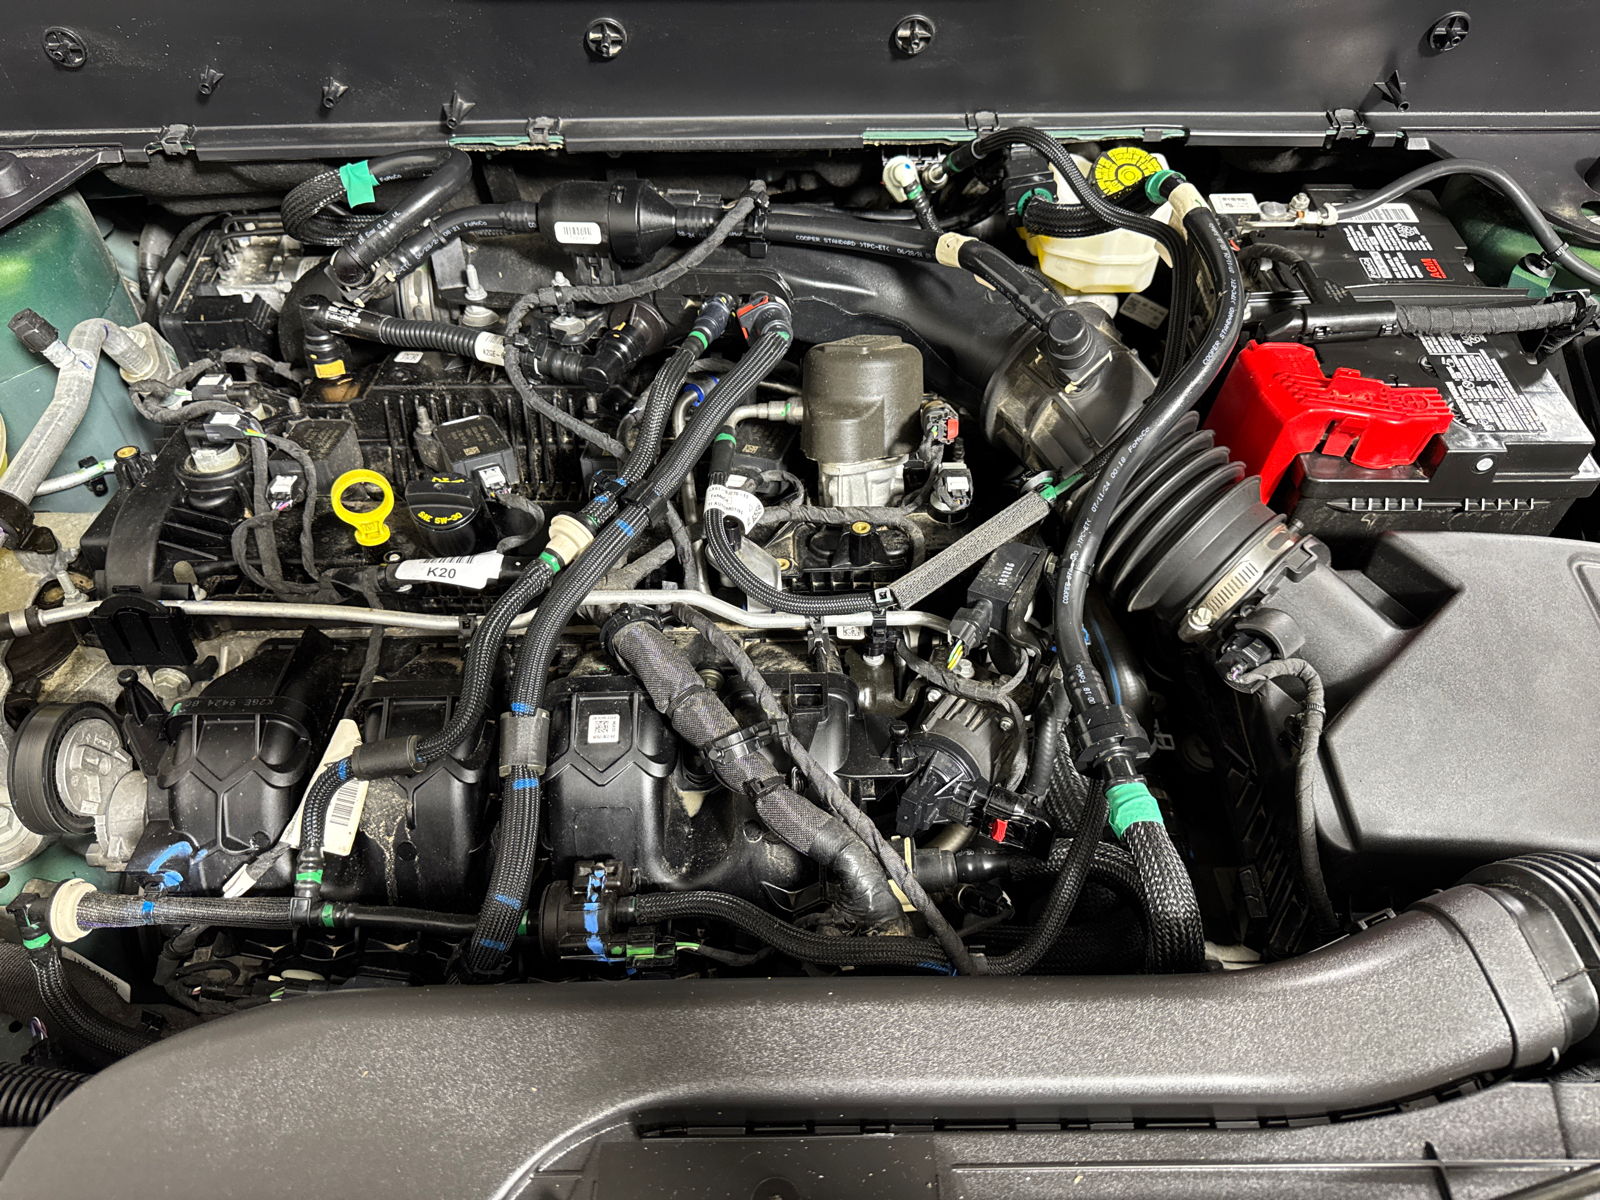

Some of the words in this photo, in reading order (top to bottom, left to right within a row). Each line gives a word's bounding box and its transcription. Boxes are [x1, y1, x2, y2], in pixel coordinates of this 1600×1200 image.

[795, 234, 821, 244] COOPER
[823, 236, 856, 247] STANDARD
[1420, 258, 1443, 279] AGM
[1202, 340, 1222, 366] COOPER
[1219, 306, 1235, 340] STANDARD
[1091, 480, 1111, 513] 07/11/24
[417, 510, 434, 523] SAE
[434, 512, 463, 524] 5W-30
[426, 566, 457, 579] K20
